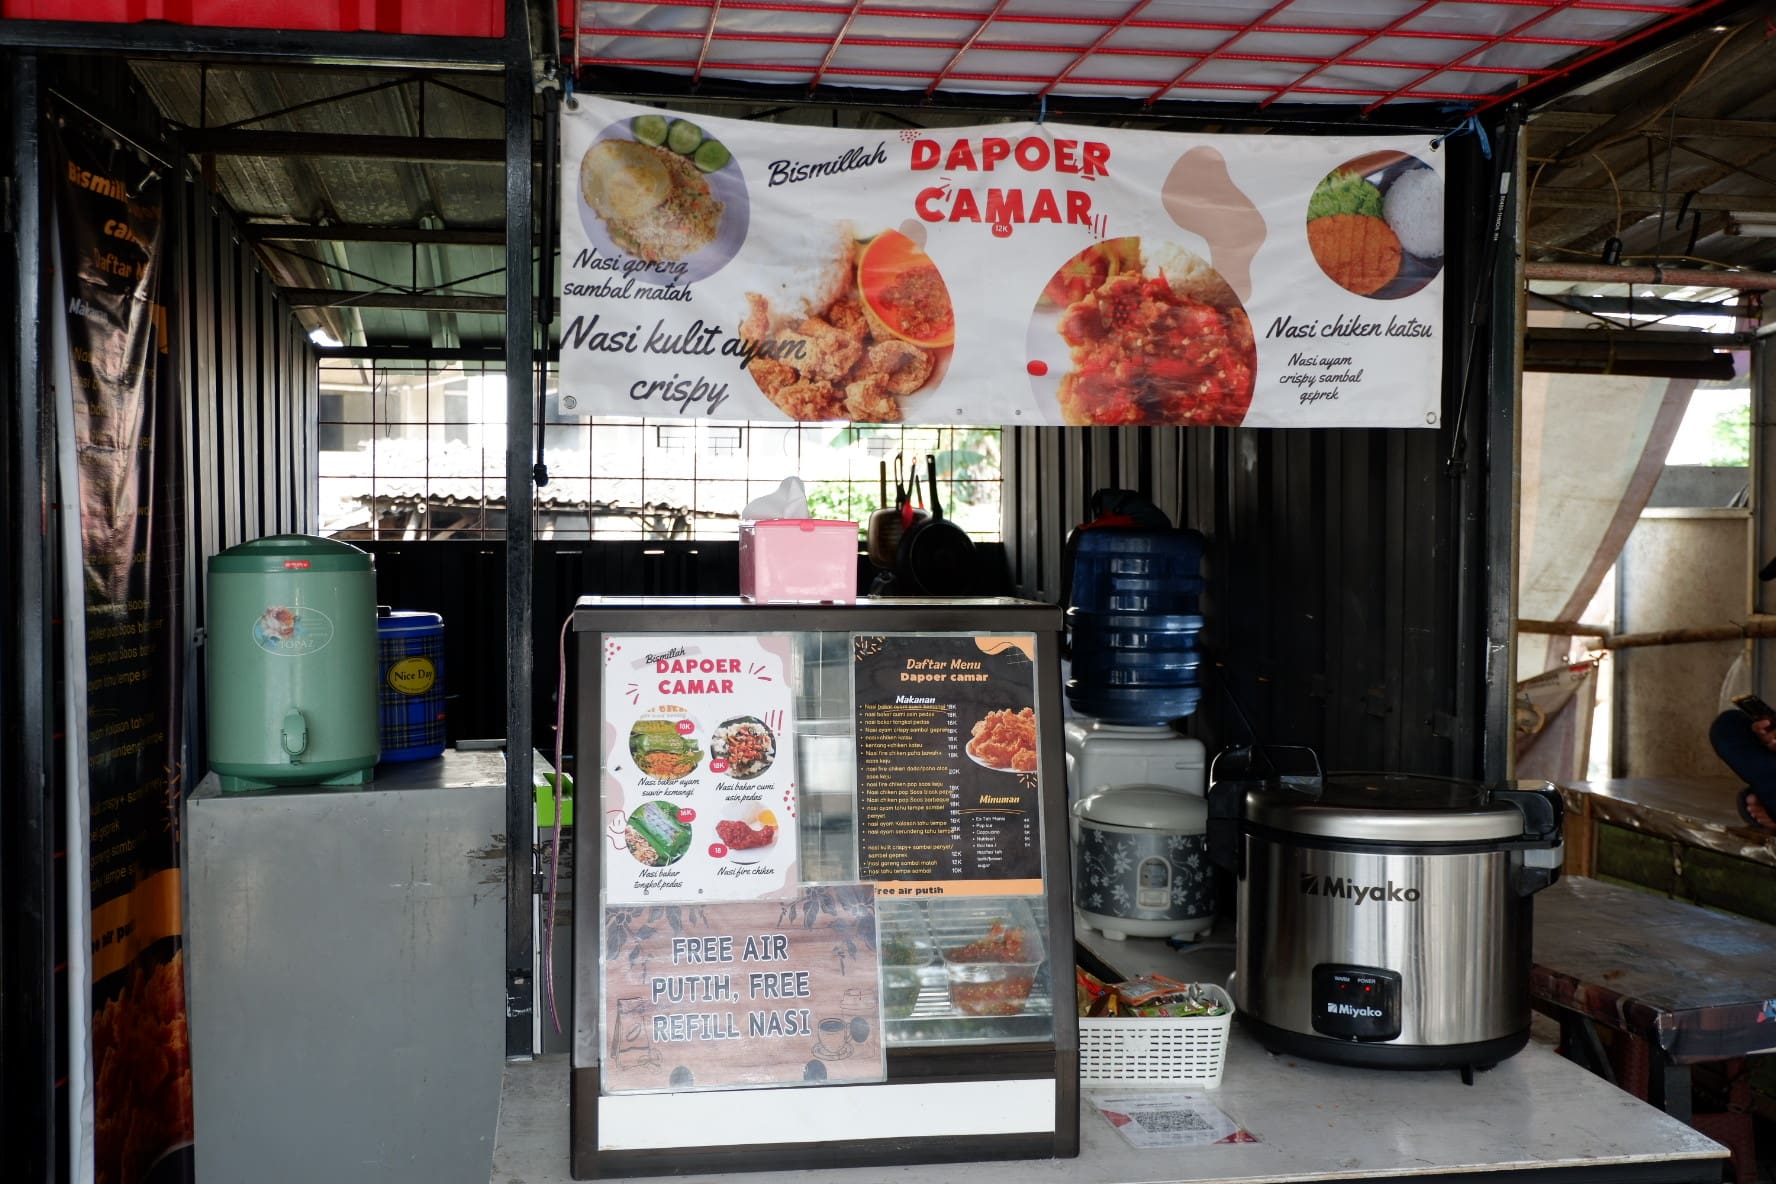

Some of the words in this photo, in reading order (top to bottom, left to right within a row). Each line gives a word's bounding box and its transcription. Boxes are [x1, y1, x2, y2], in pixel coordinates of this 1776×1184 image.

[910, 136, 1111, 177] DAPOER
[768, 141, 887, 188] Bismillah
[915, 187, 1092, 225] CAMAR
[573, 248, 619, 272] Nasi
[623, 256, 688, 279] goreng
[563, 279, 632, 300] sambal
[634, 280, 693, 302] matah
[1266, 315, 1319, 338] Nasi
[1321, 314, 1382, 337] chiken
[1385, 314, 1432, 338] katsu
[560, 313, 639, 353] Nasi
[643, 319, 716, 354] kulit
[721, 335, 807, 370] ayam
[1288, 353, 1317, 366] Nasi
[1319, 355, 1352, 370] ayam
[1280, 372, 1316, 388] crispy
[1319, 369, 1364, 383] sambal
[630, 373, 729, 414] crispy
[1300, 387, 1339, 405] geprek
[279, 639, 314, 649] TOPAZ
[645, 646, 686, 664] Bismillah
[656, 659, 742, 673] DAPOER
[906, 658, 947, 670] Daftar
[951, 658, 981, 670] Menu
[394, 671, 416, 682] Nice
[418, 669, 433, 681] Day
[900, 672, 947, 683] Dapoer
[950, 673, 989, 682] camar
[658, 680, 734, 694] CAMAR
[895, 695, 936, 704] Makanan
[638, 777, 657, 786] Nasi
[657, 777, 679, 786] bakar
[679, 779, 700, 787] ayam
[715, 782, 734, 791] Nasi
[734, 782, 756, 791] bakar
[756, 783, 775, 791] cumi
[740, 793, 763, 803] pedas
[979, 795, 1020, 803] Minuman
[638, 868, 658, 878] Nasi
[658, 869, 680, 877] bakar
[717, 867, 736, 876] Nasi
[736, 866, 751, 878] fire
[752, 866, 775, 875] chiken
[633, 880, 661, 891] tongkol
[660, 880, 683, 890] pedas
[898, 887, 913, 895] air
[915, 887, 944, 896] putih
[1323, 877, 1421, 905] Miyako
[671, 935, 734, 965] FREE
[742, 934, 789, 963] AIR
[651, 974, 740, 1004] PUTIH,
[749, 971, 811, 1000] FREE
[1338, 1004, 1383, 1018] Miyako
[652, 1012, 740, 1043] REFILL
[749, 1008, 812, 1038] NASI
